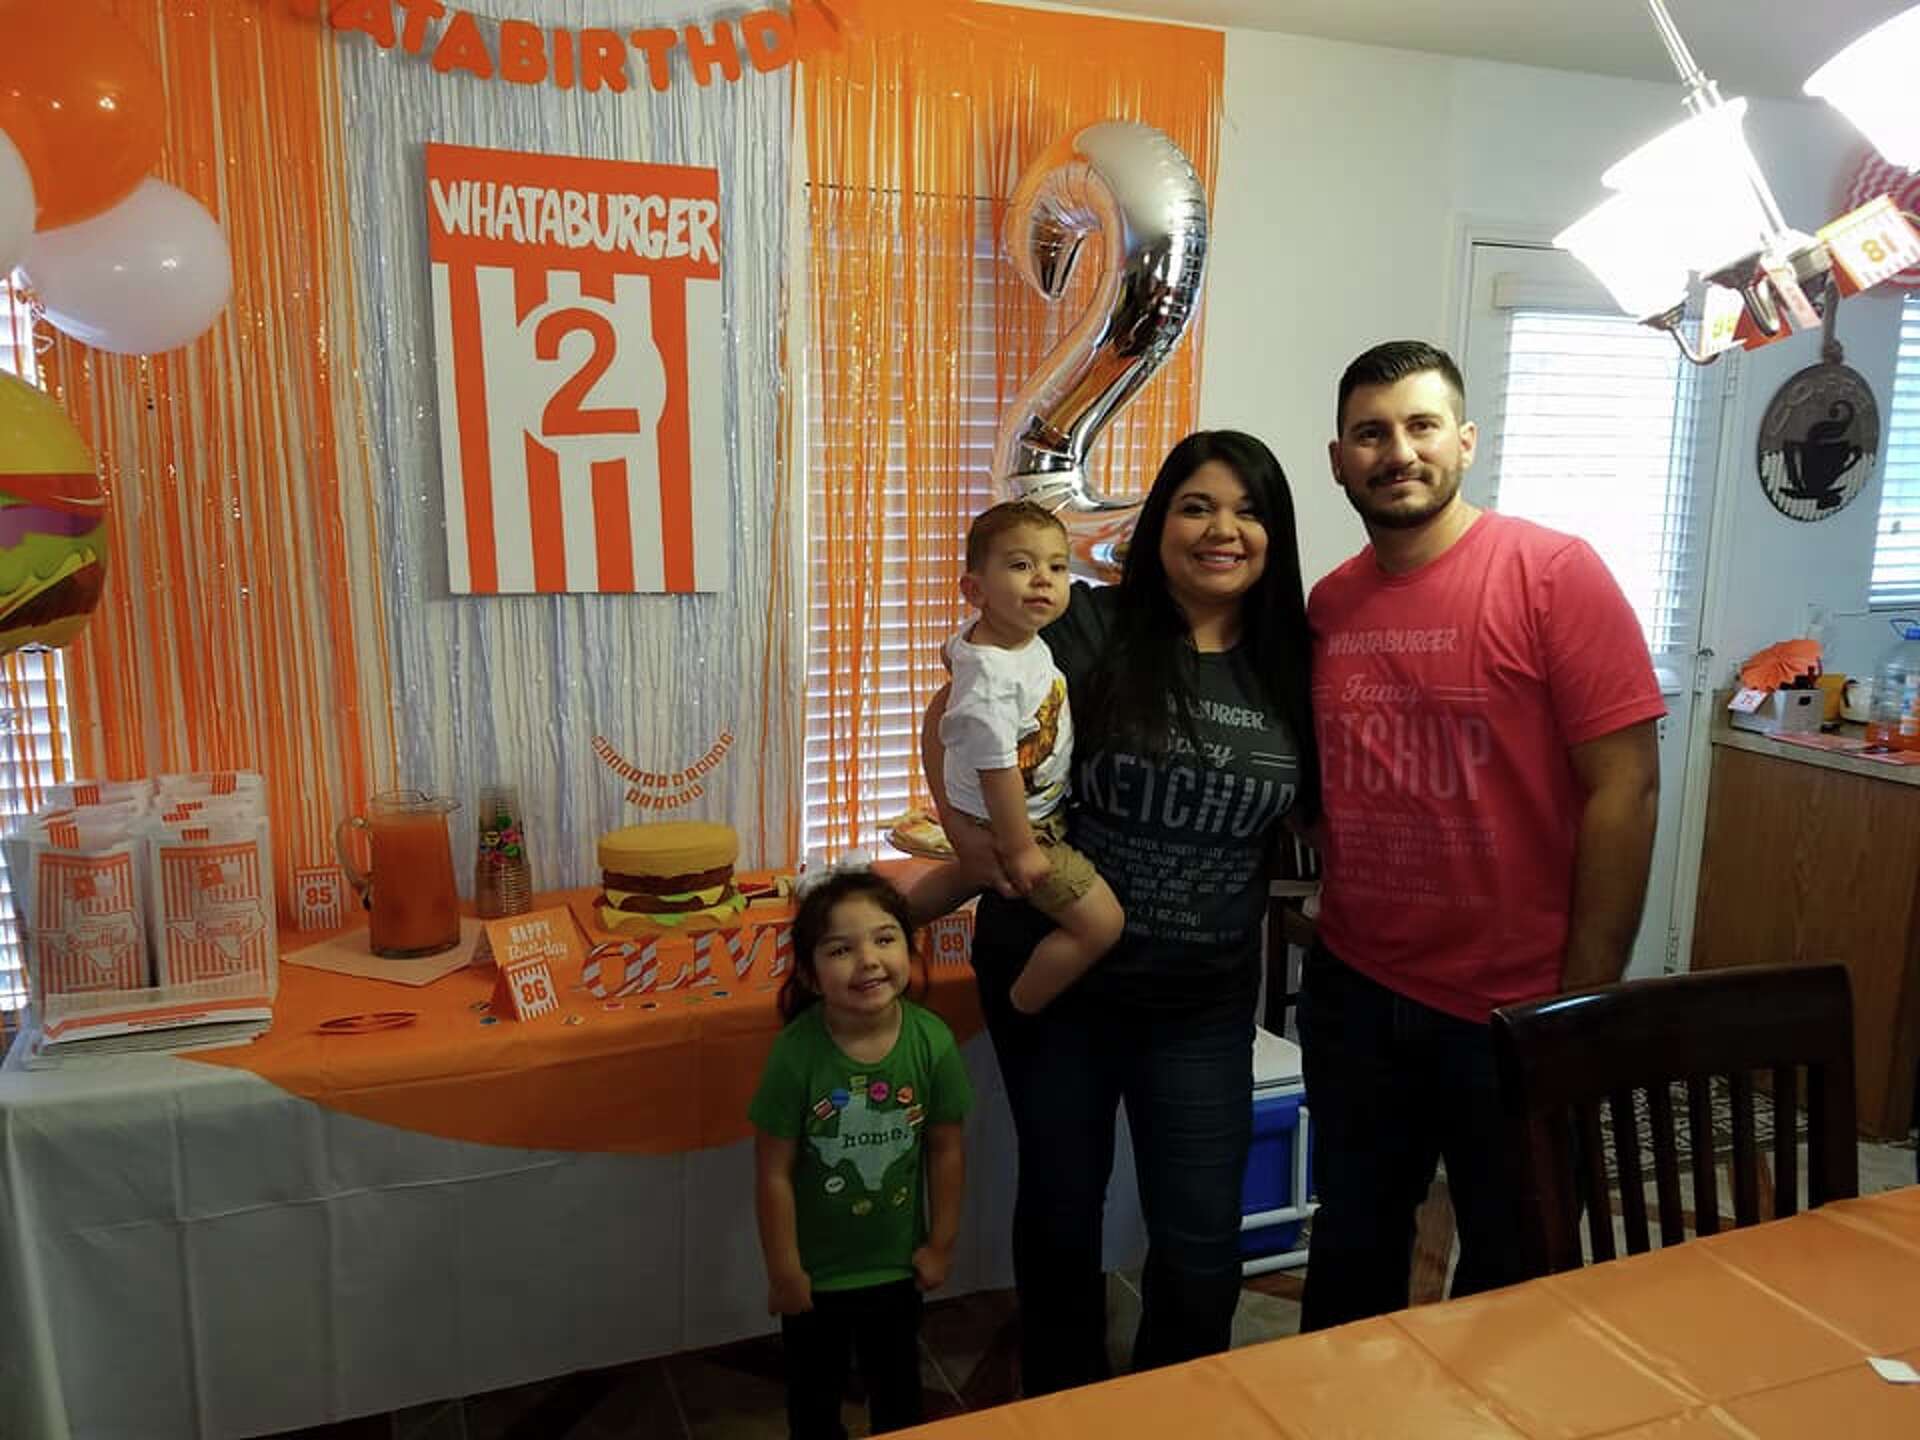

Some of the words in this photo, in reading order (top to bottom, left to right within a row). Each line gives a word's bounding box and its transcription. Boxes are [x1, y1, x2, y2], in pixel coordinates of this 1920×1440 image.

[430, 178, 720, 264] WHATABURGER
[535, 306, 640, 437] 2
[1327, 626, 1458, 656] WHATABURGER
[1342, 673, 1421, 706] Fancy
[521, 978, 548, 1005] 86
